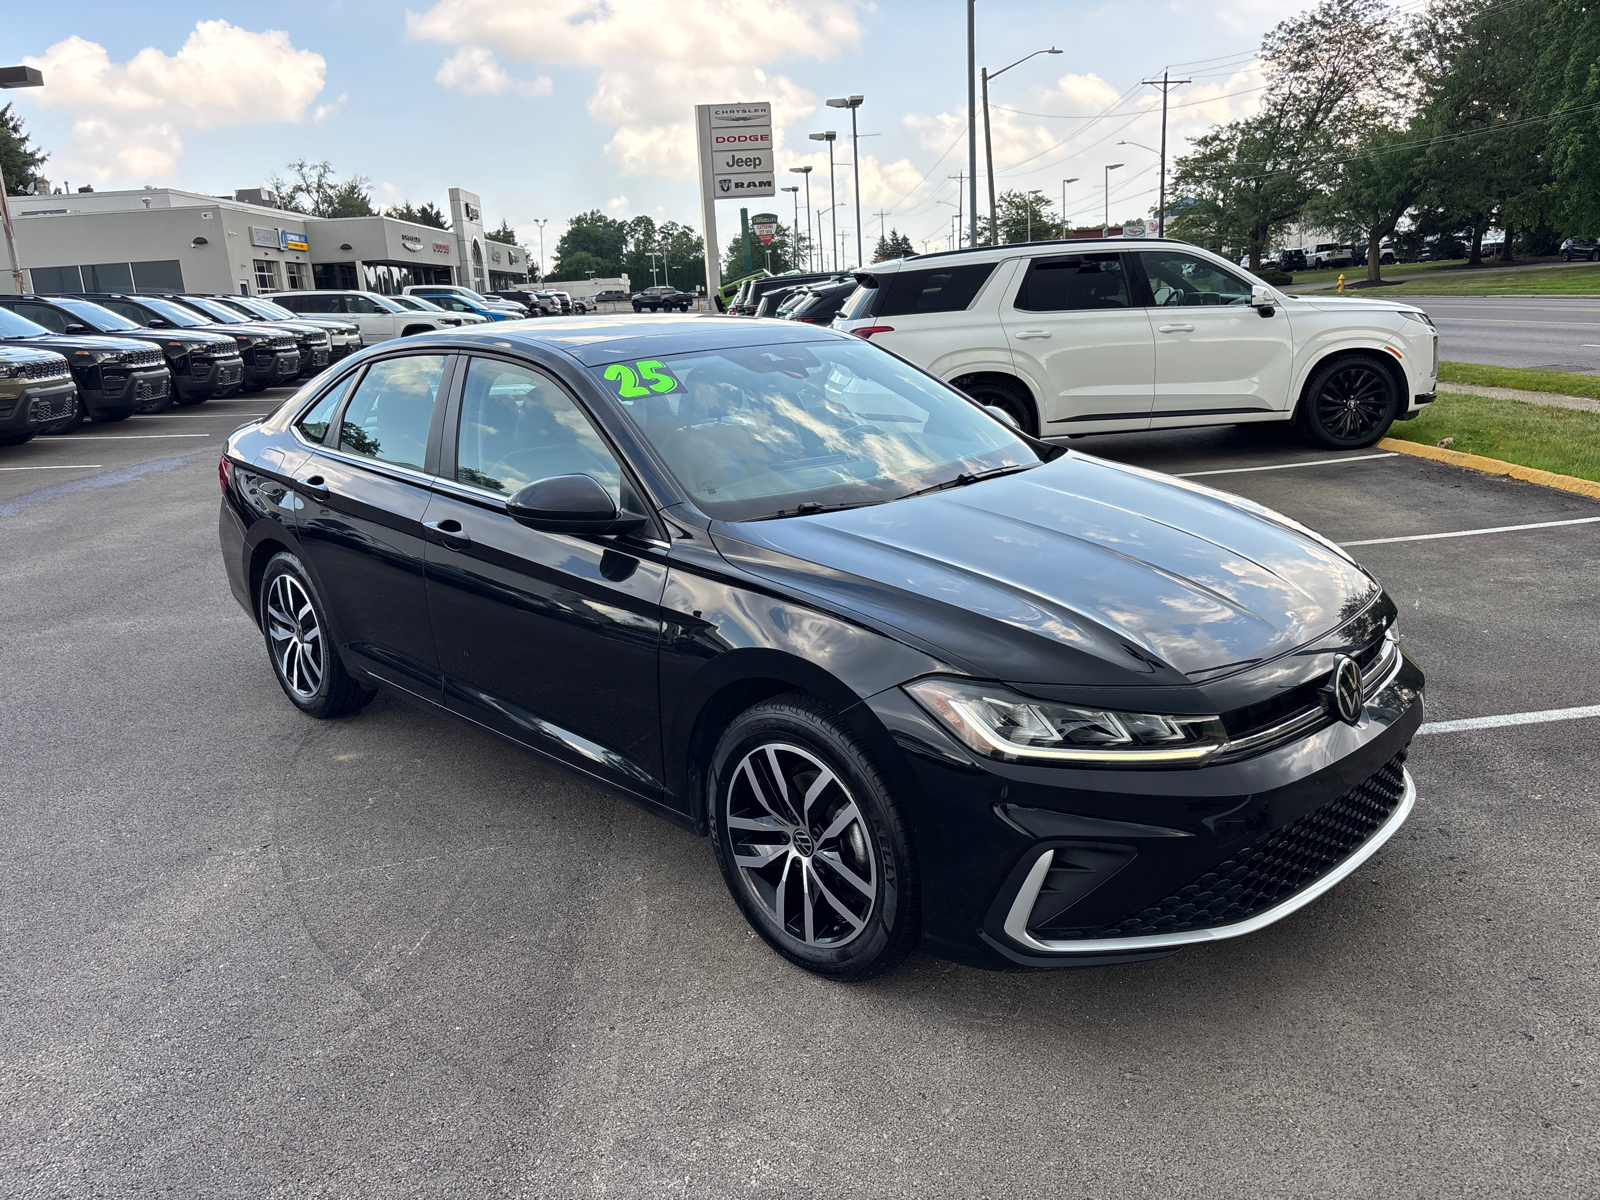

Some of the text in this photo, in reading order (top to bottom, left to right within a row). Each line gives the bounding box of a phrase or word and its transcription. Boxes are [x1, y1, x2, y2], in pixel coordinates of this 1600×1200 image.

[715, 134, 770, 144] DODGE
[725, 154, 763, 170] Jeep
[734, 180, 773, 189] RAM
[256, 231, 278, 244] Service
[603, 360, 678, 398] 25
[873, 818, 897, 890] KELLY
